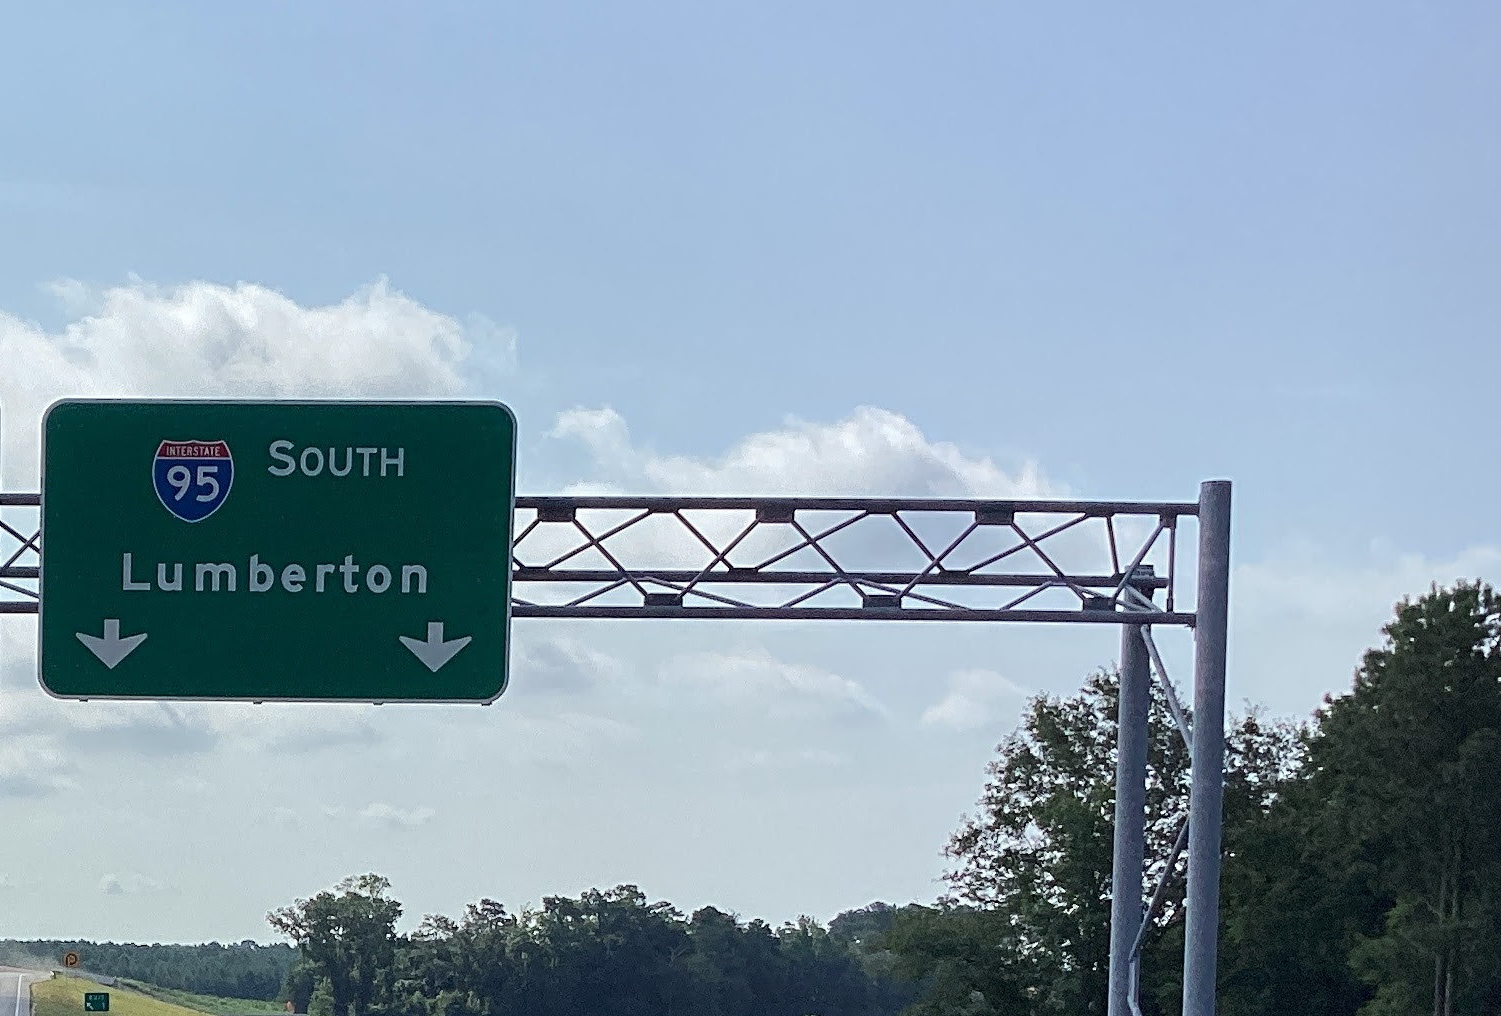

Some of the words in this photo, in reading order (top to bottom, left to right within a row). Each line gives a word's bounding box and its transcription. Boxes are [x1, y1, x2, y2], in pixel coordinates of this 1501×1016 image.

[166, 445, 221, 457] INTERSTATE
[267, 439, 405, 478] SOUTH
[166, 465, 220, 502] 95
[121, 551, 428, 594] Lumberton
